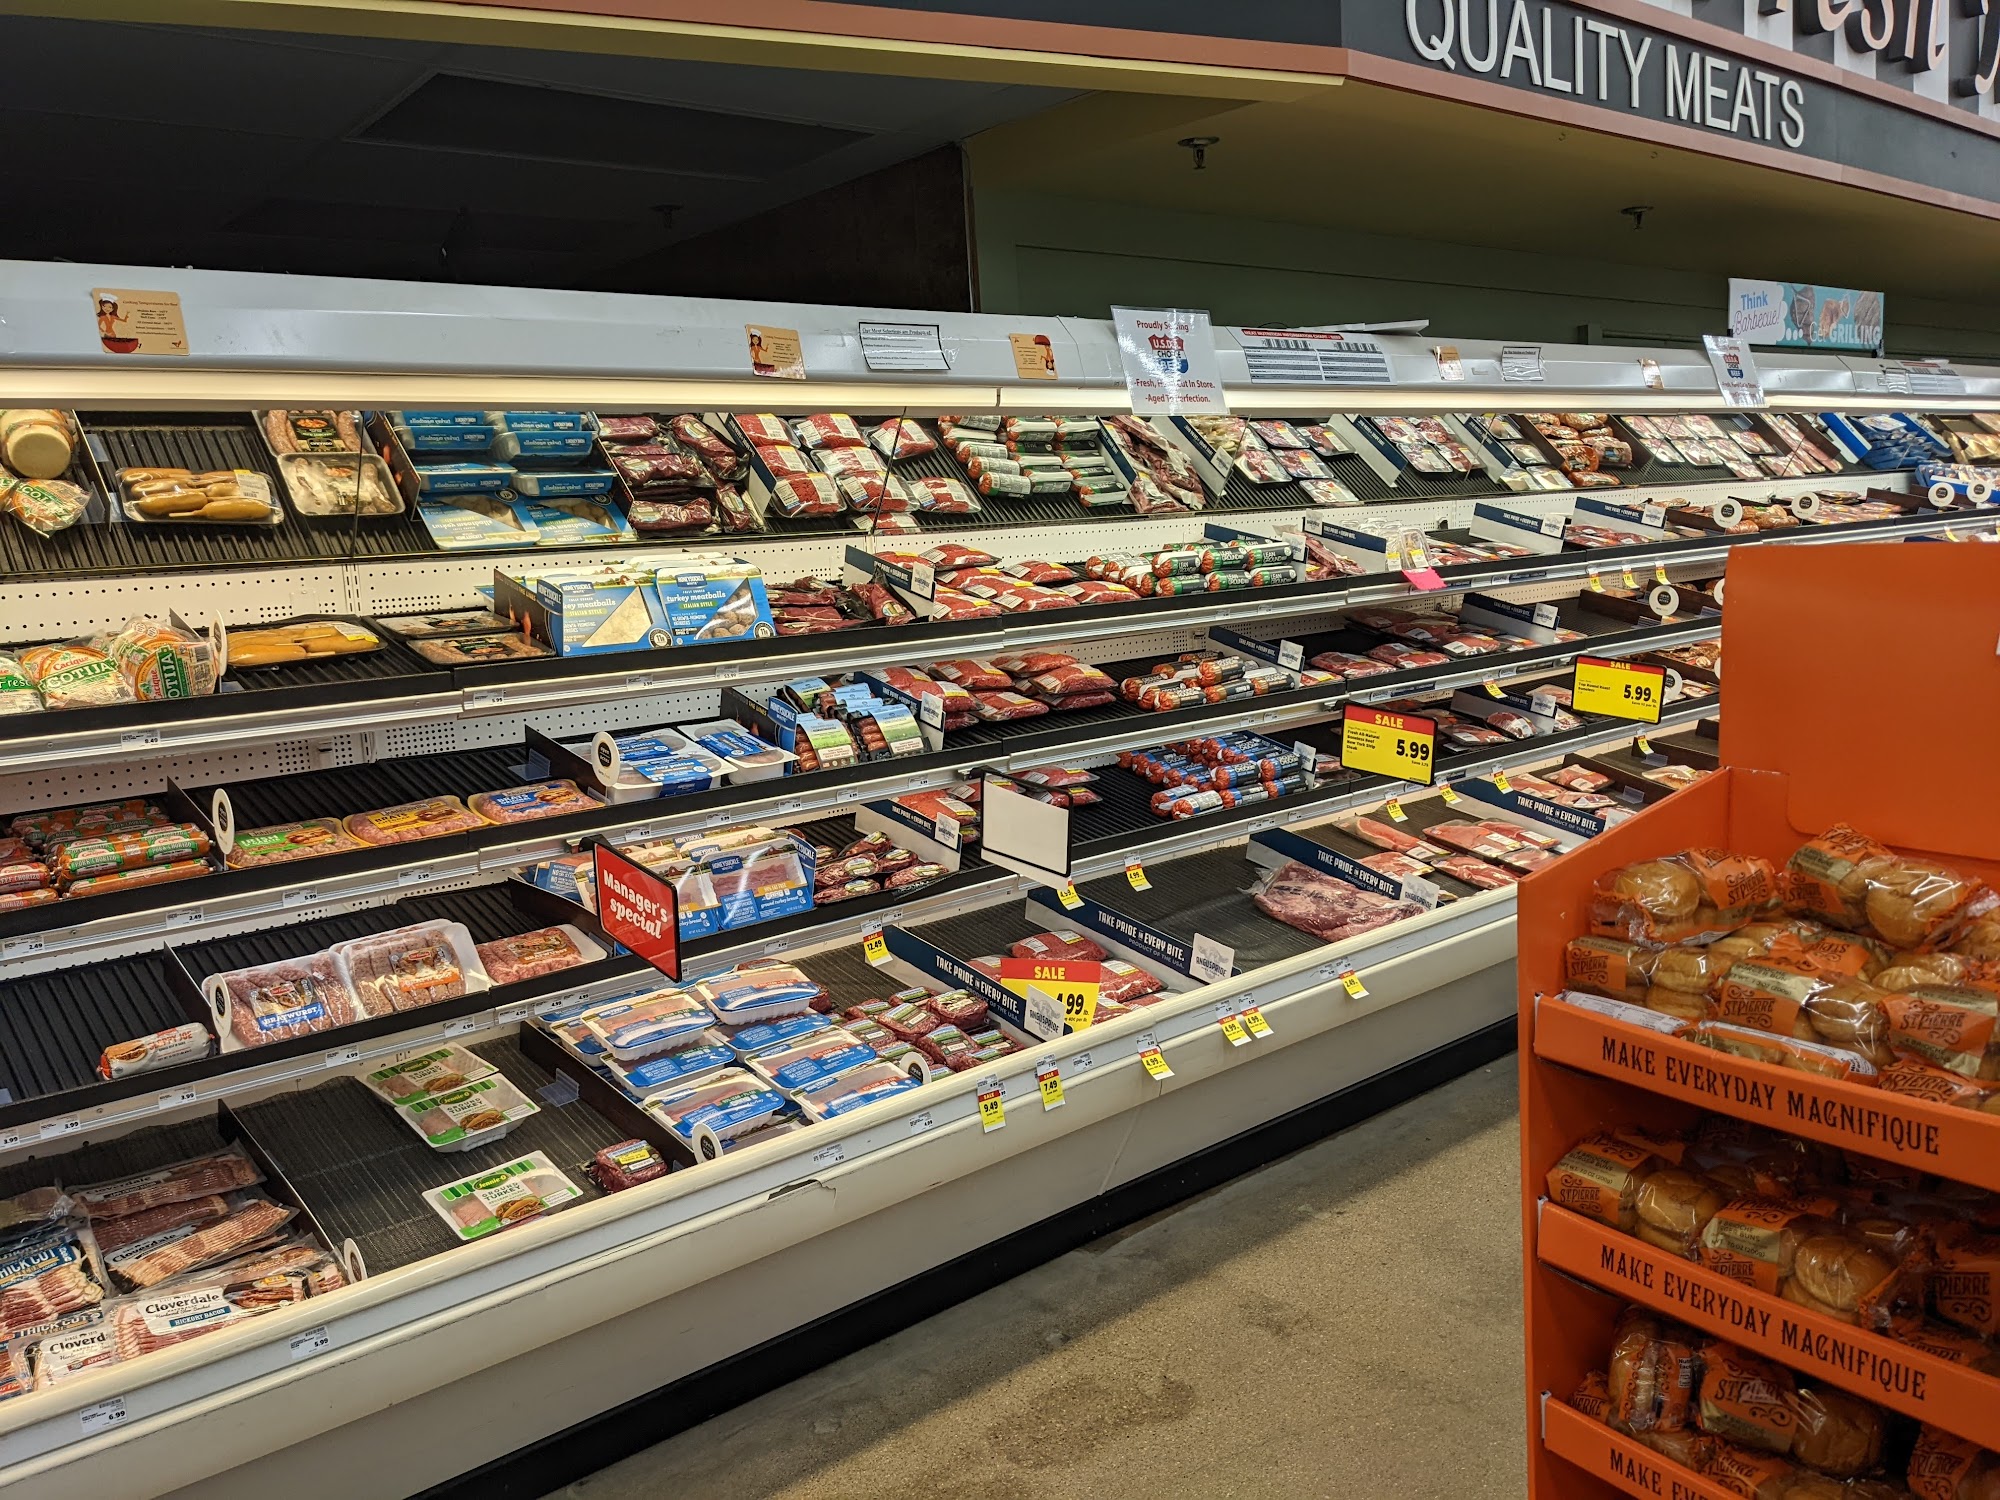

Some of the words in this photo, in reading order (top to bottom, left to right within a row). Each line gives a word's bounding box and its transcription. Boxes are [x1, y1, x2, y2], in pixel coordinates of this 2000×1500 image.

[1405, 0, 1652, 108] QUALITY
[1665, 44, 1806, 149] MEATS
[1740, 290, 1769, 311] Think
[1136, 320, 1163, 331] Proudly
[1732, 301, 1782, 336] Barbecue!
[1829, 324, 1881, 345] GRILLING
[1196, 380, 1216, 389] Store.
[1145, 394, 1166, 405] -Aged
[1263, 551, 1276, 559] LEAN
[538, 583, 562, 604] HONEYSUCKLE
[563, 583, 592, 591] HONEYSUCKLE
[577, 598, 616, 608] meatballs
[666, 594, 689, 603] turkey
[690, 590, 726, 600] meatballs
[53, 656, 89, 671] Cacique
[1610, 661, 1631, 670] SALE
[45, 661, 111, 689] COTIJA
[1623, 684, 1652, 702] 5.99
[771, 701, 795, 721] HONEYSUCKLE
[1375, 714, 1404, 729] SALE
[1396, 739, 1430, 761] 5.99
[669, 761, 695, 769] patties
[1517, 795, 1533, 809] TAKE
[1534, 801, 1554, 817] PRIDE
[1560, 810, 1581, 825] EVERY
[1581, 816, 1598, 831] BITE.
[167, 841, 192, 851] CHORIZO
[691, 845, 719, 858] HONEYSUCKLE
[73, 859, 90, 868] PORK
[91, 855, 117, 865] CHORIZO
[712, 858, 742, 869] HONEYSUCKLE
[15, 872, 40, 881] CHORIZO
[1129, 871, 1140, 879] 4.99
[1317, 849, 1333, 867] TAKE
[1334, 854, 1353, 875] PRIDE
[1359, 869, 1379, 890] EVERY
[1380, 878, 1395, 895] BITE.
[603, 869, 668, 923] Manager's
[610, 896, 662, 940] special
[1098, 910, 1115, 928] TAKE
[1116, 916, 1137, 938] PRIDE
[1143, 931, 1166, 952] EVERY
[1167, 942, 1185, 961] BITE.
[867, 939, 882, 951] 12.49
[1128, 938, 1152, 954] PRODUCT
[1034, 966, 1066, 980] SALE
[935, 955, 952, 975] TAKE
[953, 963, 974, 985] PRIDE
[980, 980, 1001, 1002] EVERY
[1001, 992, 1019, 1014] BITE.
[967, 985, 988, 1006] PRODUCT
[1737, 998, 1775, 1015] PIERRE
[263, 1005, 318, 1024] BRATWURST
[1247, 1015, 1259, 1025] 4.99
[1224, 1023, 1237, 1033] 4.99
[179, 1031, 193, 1042] JOE
[1146, 1057, 1159, 1067] 4.99
[408, 1064, 441, 1077] GROUND
[410, 1067, 443, 1080] TURKEY
[1043, 1071, 1054, 1080] SALE
[1044, 1080, 1058, 1091] 7.49
[441, 1091, 470, 1105] Jennie-O
[983, 1092, 995, 1100] SALE
[1601, 1034, 1656, 1076] MAKE
[1665, 1055, 1777, 1112] EVERYDAY
[1787, 1088, 1940, 1156] MAGNIFIQUE
[447, 1097, 482, 1111] GROUND
[450, 1100, 484, 1115] TURKEY
[983, 1101, 998, 1112] 9.49
[477, 1173, 507, 1189] Jennie-O
[482, 1181, 519, 1198] GROUND
[484, 1185, 521, 1202] TURKEY
[1572, 1188, 1600, 1200] PIERRE
[112, 1234, 176, 1261] Cloverdale
[32, 1250, 56, 1265] CUT
[144, 1292, 220, 1314] Cloverdale
[175, 1311, 204, 1325] HICKORY
[204, 1308, 226, 1318] BACON
[1600, 1243, 1654, 1291] MAKE
[1663, 1270, 1772, 1338] EVERYDAY
[1782, 1316, 1928, 1401] MAGNIFIQUE
[107, 1409, 126, 1420] 6.99
[1609, 1447, 1662, 1497] MAKE
